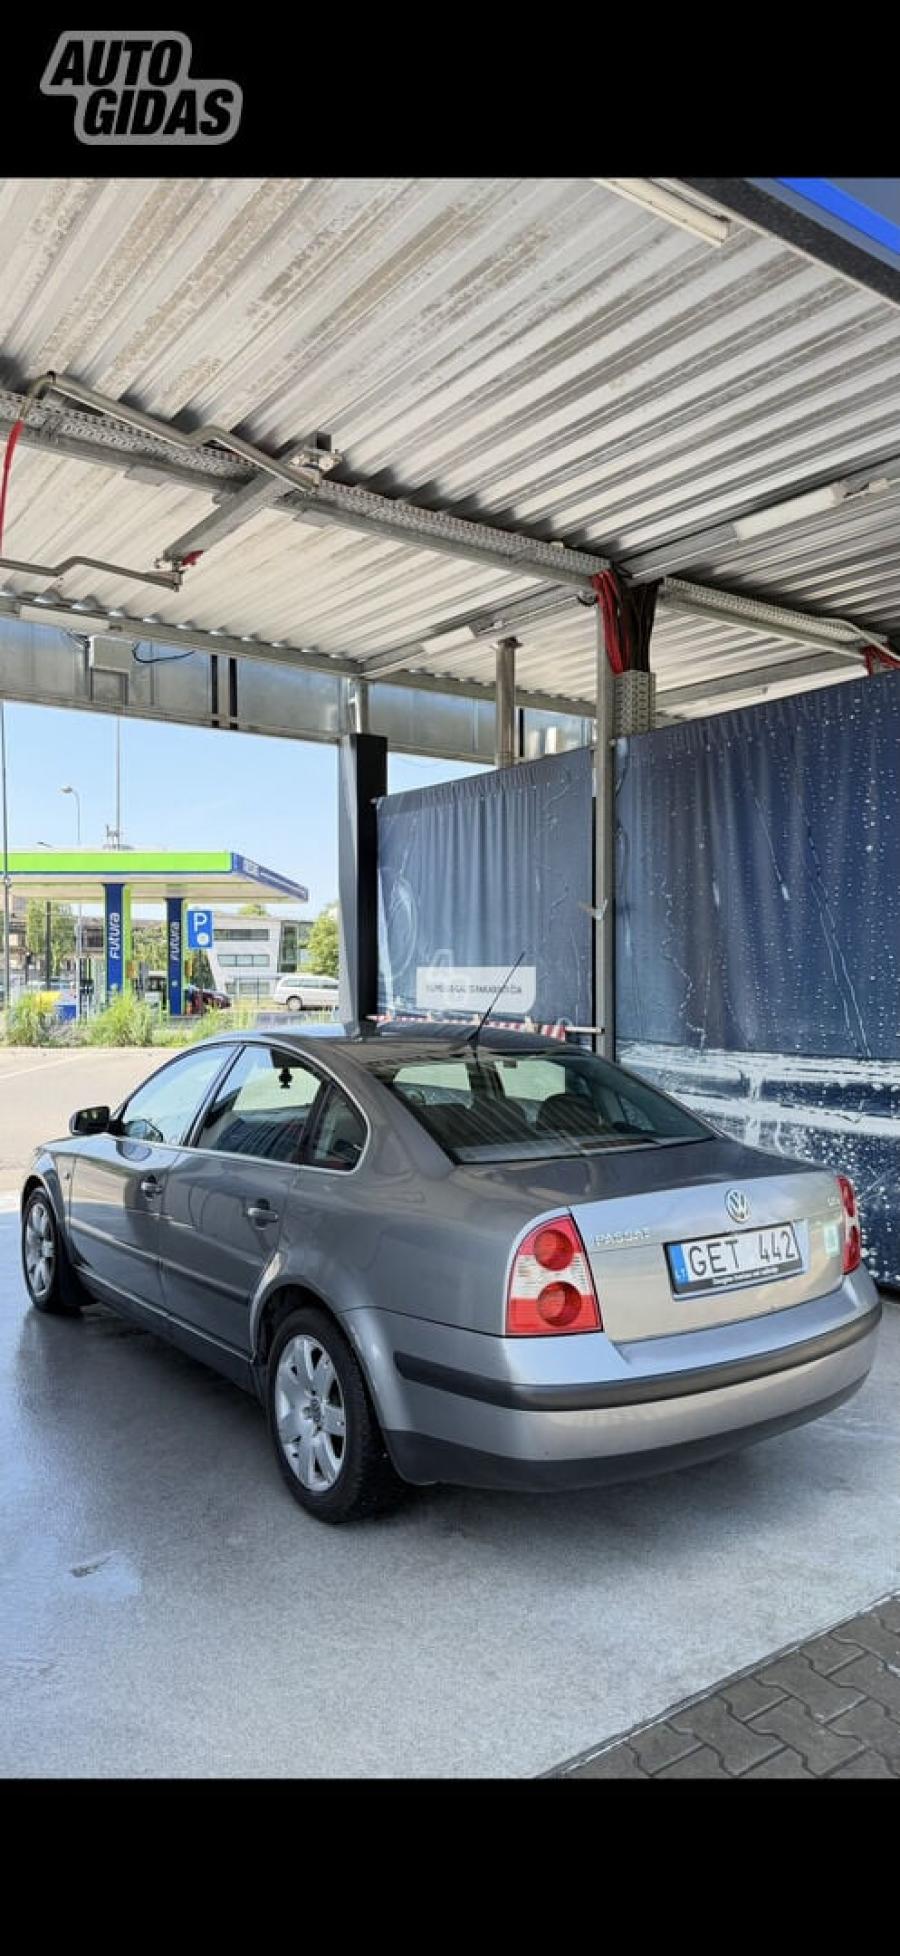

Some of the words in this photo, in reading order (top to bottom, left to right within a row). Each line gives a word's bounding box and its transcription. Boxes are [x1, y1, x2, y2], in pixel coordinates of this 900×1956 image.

[193, 912, 207, 932] P
[689, 1239, 740, 1276] GET
[758, 1230, 796, 1262] 442
